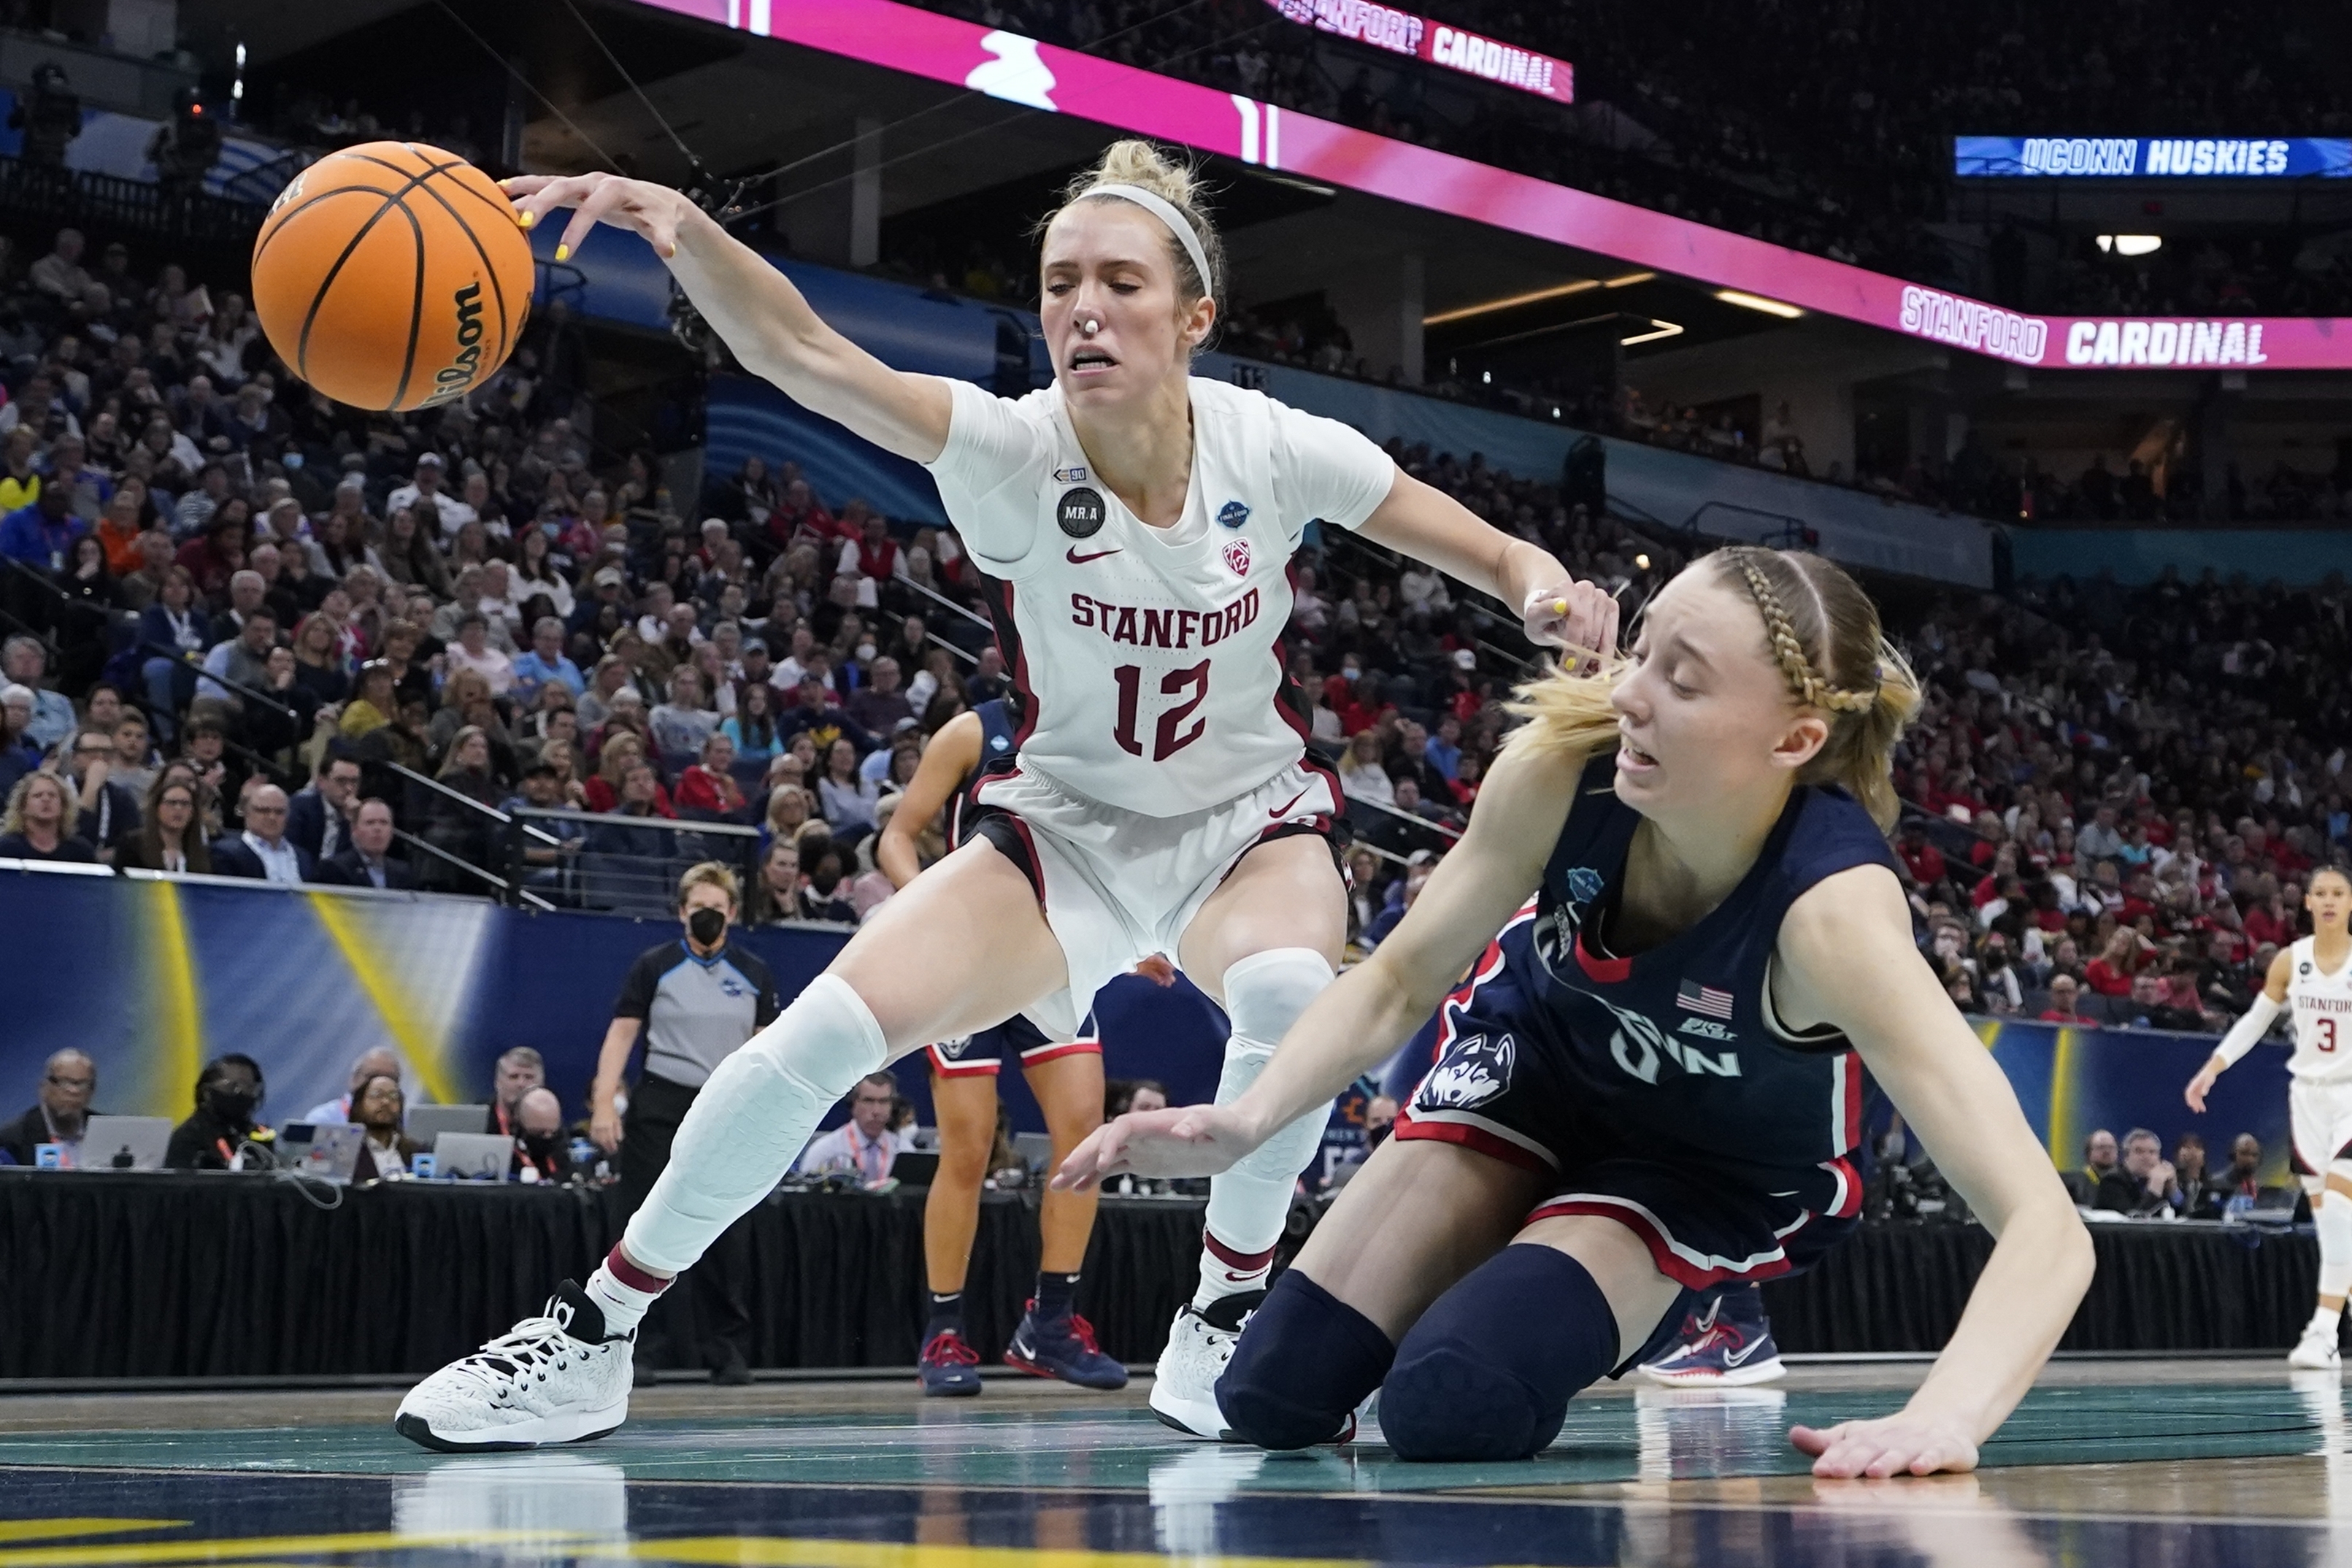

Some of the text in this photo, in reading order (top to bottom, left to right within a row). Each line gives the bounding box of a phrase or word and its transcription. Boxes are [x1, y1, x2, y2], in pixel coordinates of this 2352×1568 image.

[1431, 26, 1555, 95] CARDINAL
[2021, 138, 2289, 174] UCONN HUSKIES
[1899, 285, 2268, 366] STANFORD CARDINAL
[1223, 539, 1250, 566] PAC
[1233, 555, 1248, 572] 12
[1071, 587, 1259, 649] STANFORD
[1113, 658, 1211, 762] 12
[2317, 1018, 2337, 1052] 3
